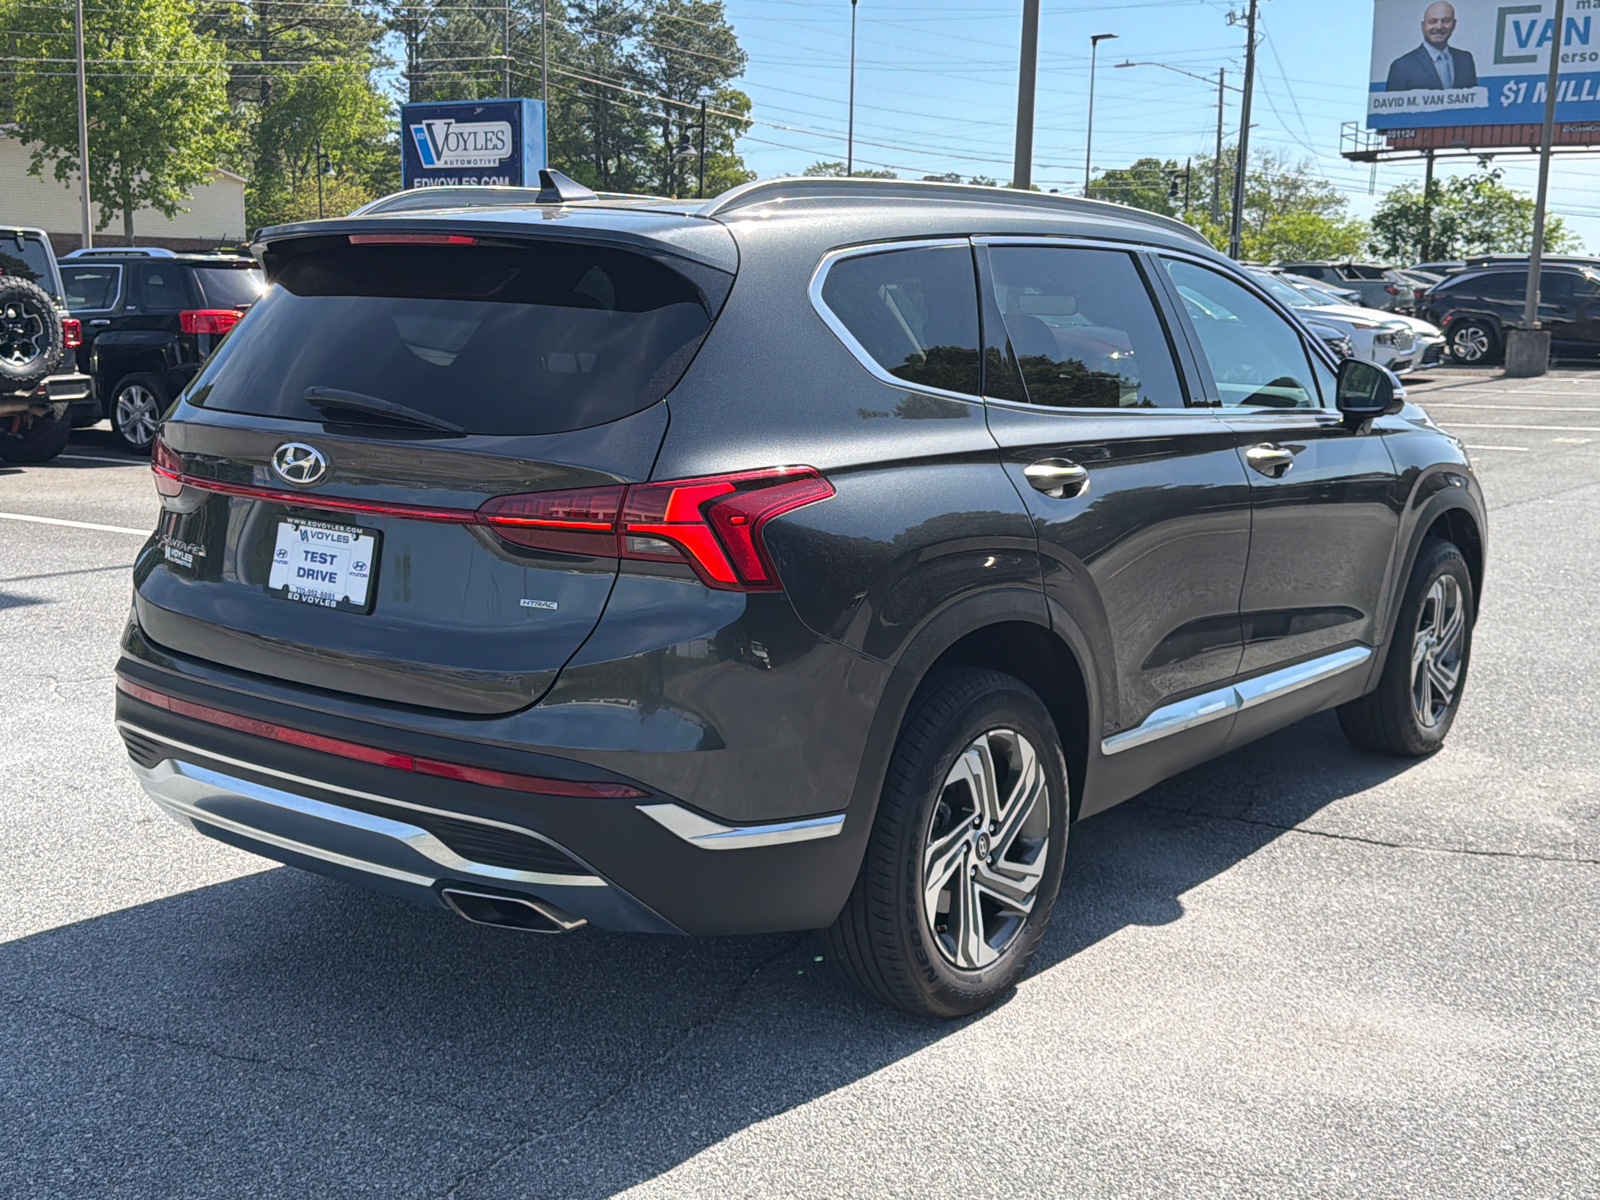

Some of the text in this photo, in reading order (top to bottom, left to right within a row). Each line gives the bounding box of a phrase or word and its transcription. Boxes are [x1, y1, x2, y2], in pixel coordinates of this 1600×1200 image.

[1512, 16, 1591, 49] VAN
[1560, 51, 1599, 63] erso
[1373, 93, 1476, 109] DAVID M. VAN SANT
[1500, 80, 1528, 107] $1
[413, 177, 509, 188] EDVOYLESCOM
[286, 517, 363, 534] WWW.EDVOYLES.COM
[310, 530, 350, 544] VOYLES
[303, 550, 338, 566] TEST
[297, 566, 338, 584] DRIVE
[288, 592, 337, 608] ED VOYLES
[522, 600, 555, 609] HTRAC
